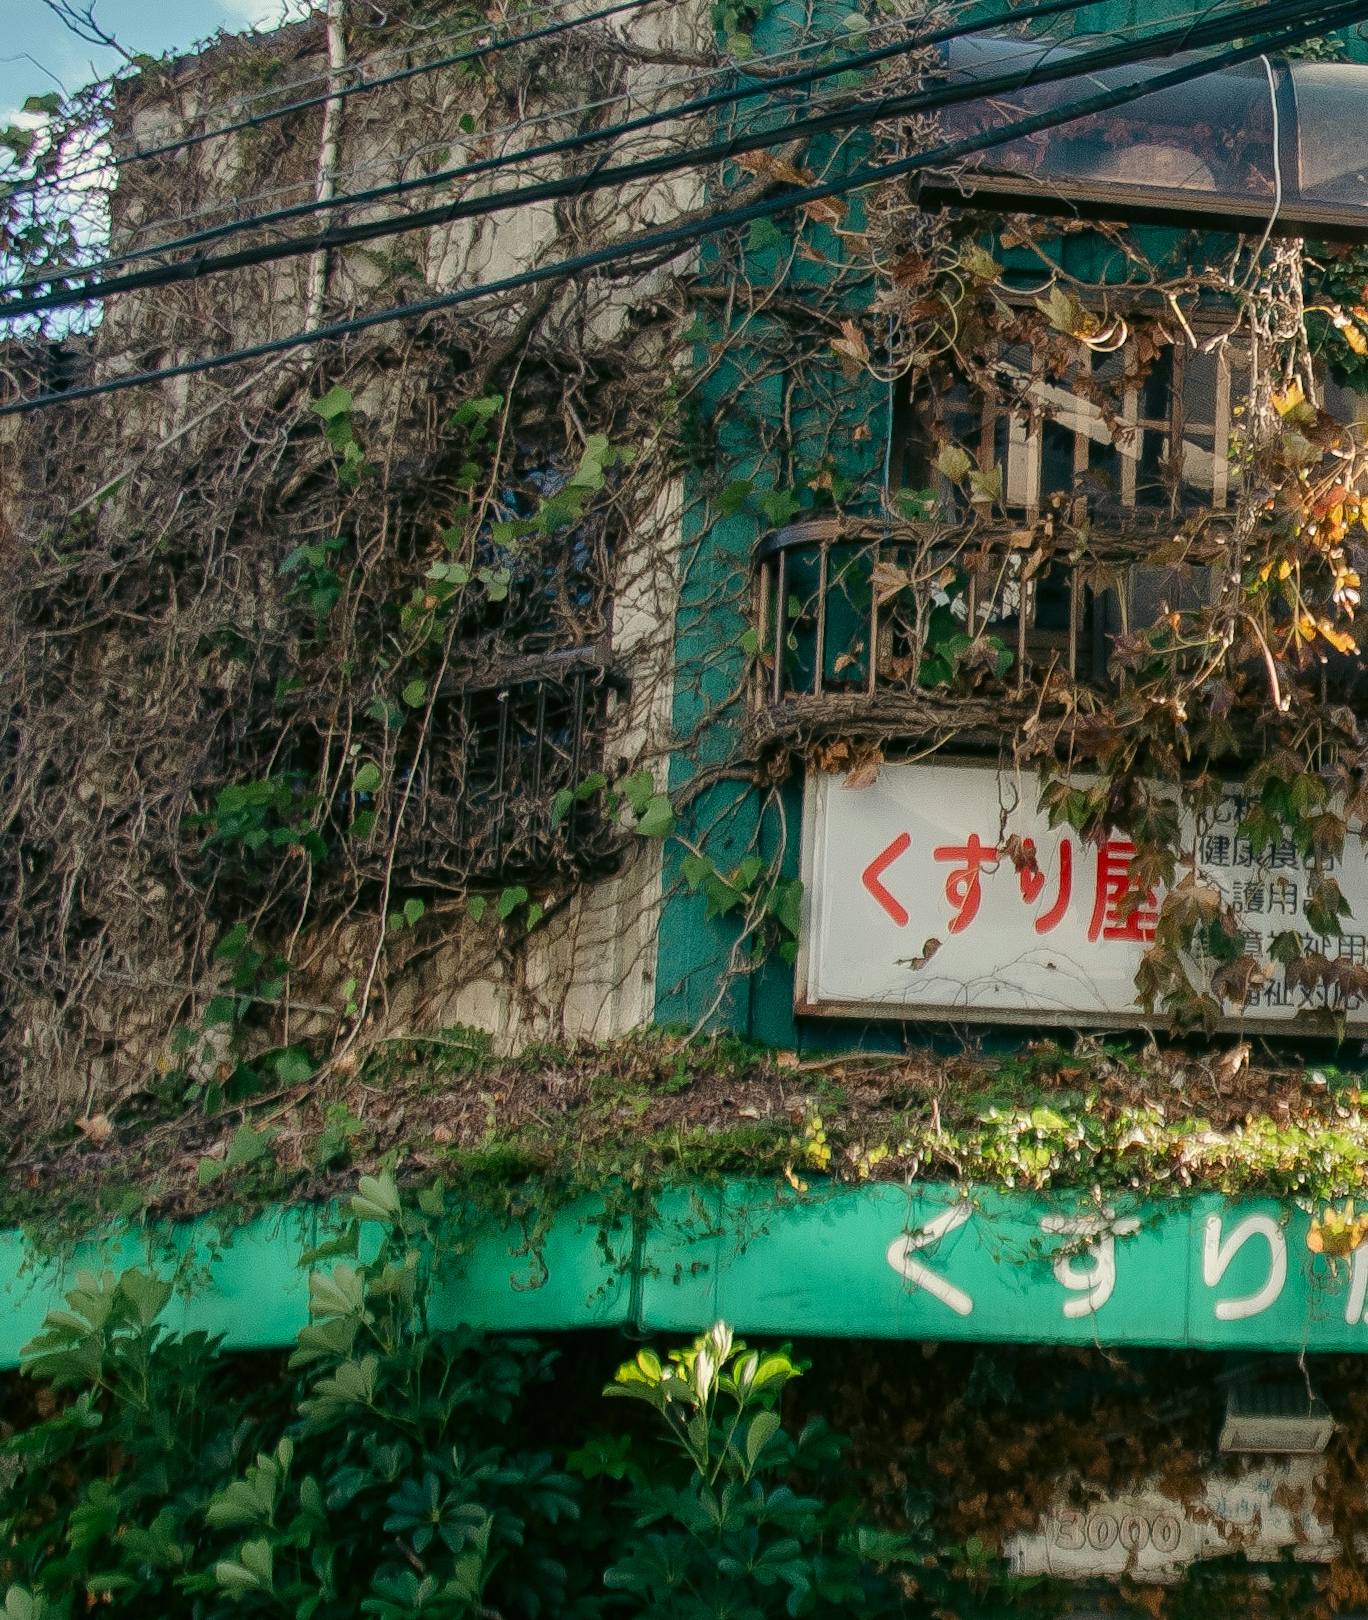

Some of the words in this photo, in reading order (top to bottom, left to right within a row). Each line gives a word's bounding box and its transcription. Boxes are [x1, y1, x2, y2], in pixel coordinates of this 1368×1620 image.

[862, 833, 1159, 943] くすり屋
[1200, 835, 1333, 870] 健康食
